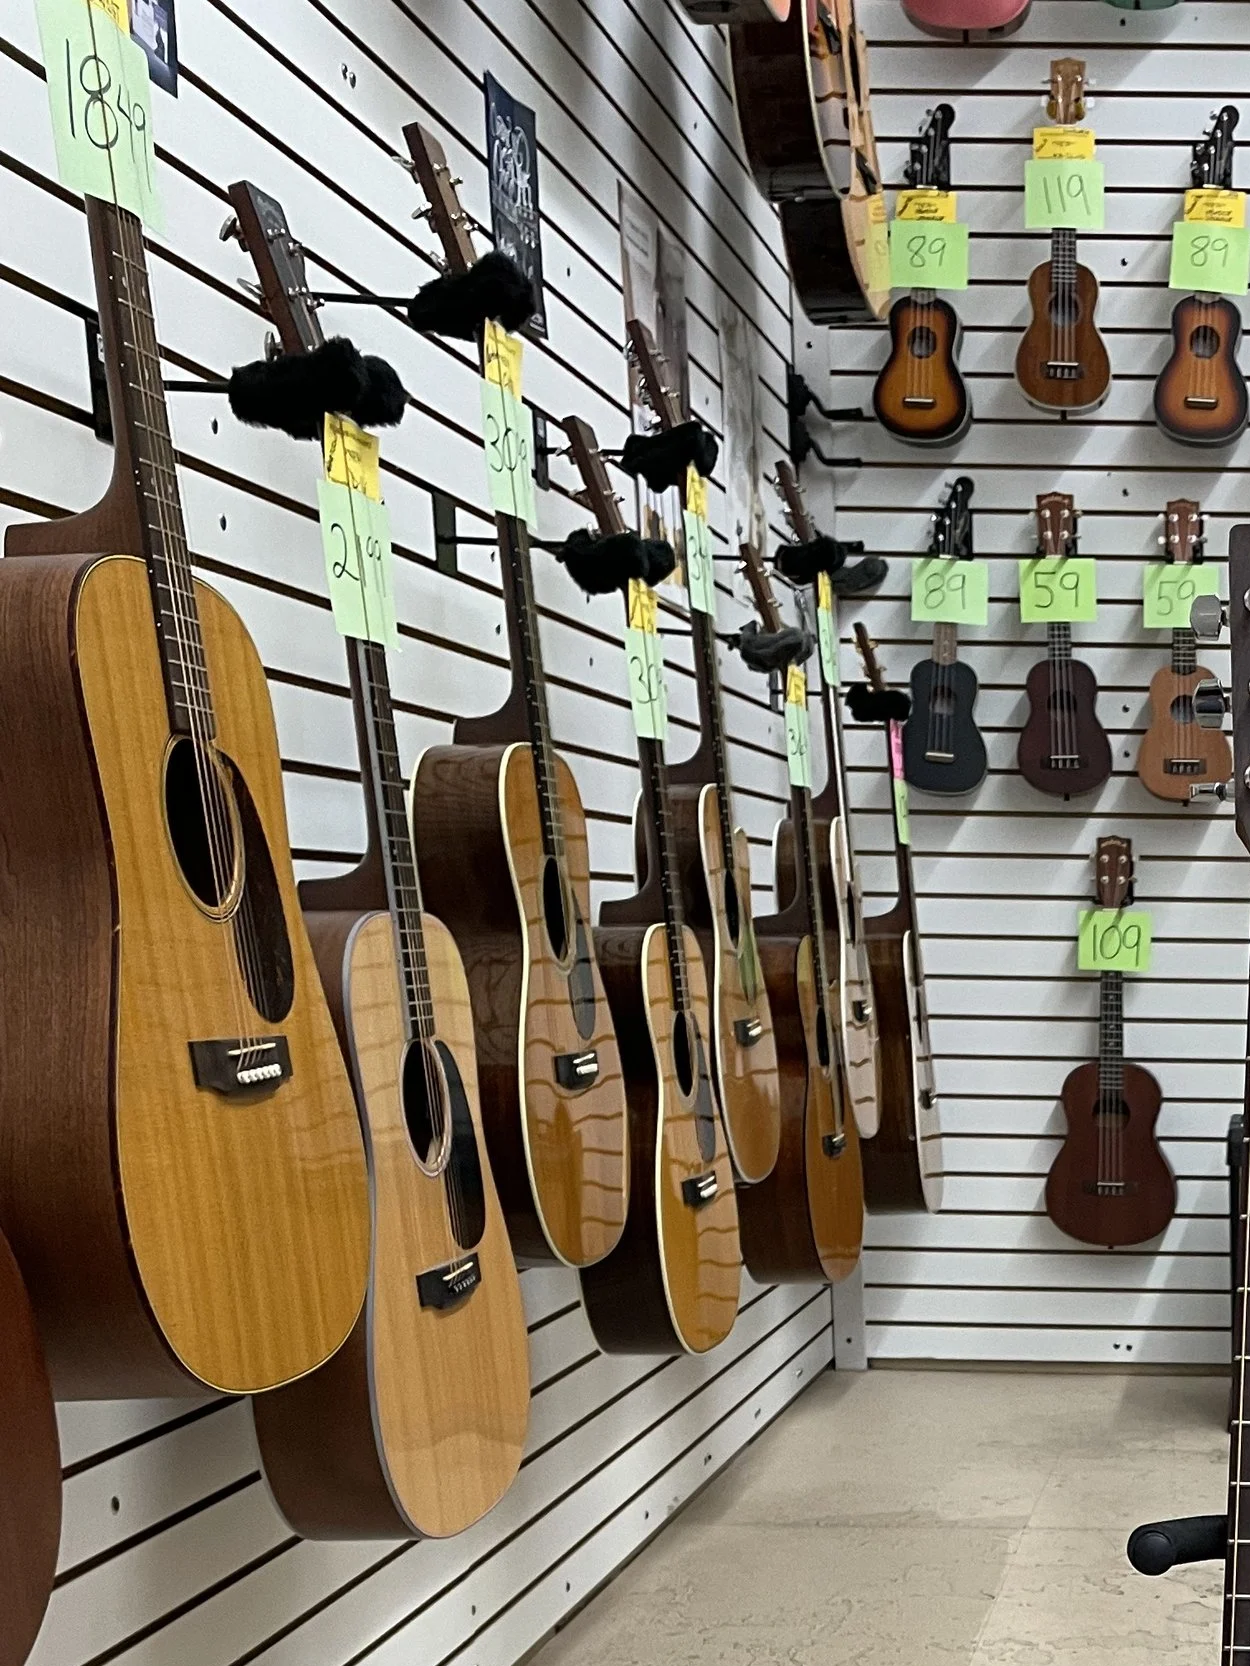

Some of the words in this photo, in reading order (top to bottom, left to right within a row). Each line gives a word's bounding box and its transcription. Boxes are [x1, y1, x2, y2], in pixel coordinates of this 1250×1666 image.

[1042, 173, 1092, 215] 119
[907, 235, 947, 268] 89
[1190, 236, 1229, 267] 89
[923, 571, 967, 611] 89
[1032, 570, 1080, 608] 59
[1156, 580, 1195, 616] 59
[1092, 924, 1142, 967] 109
